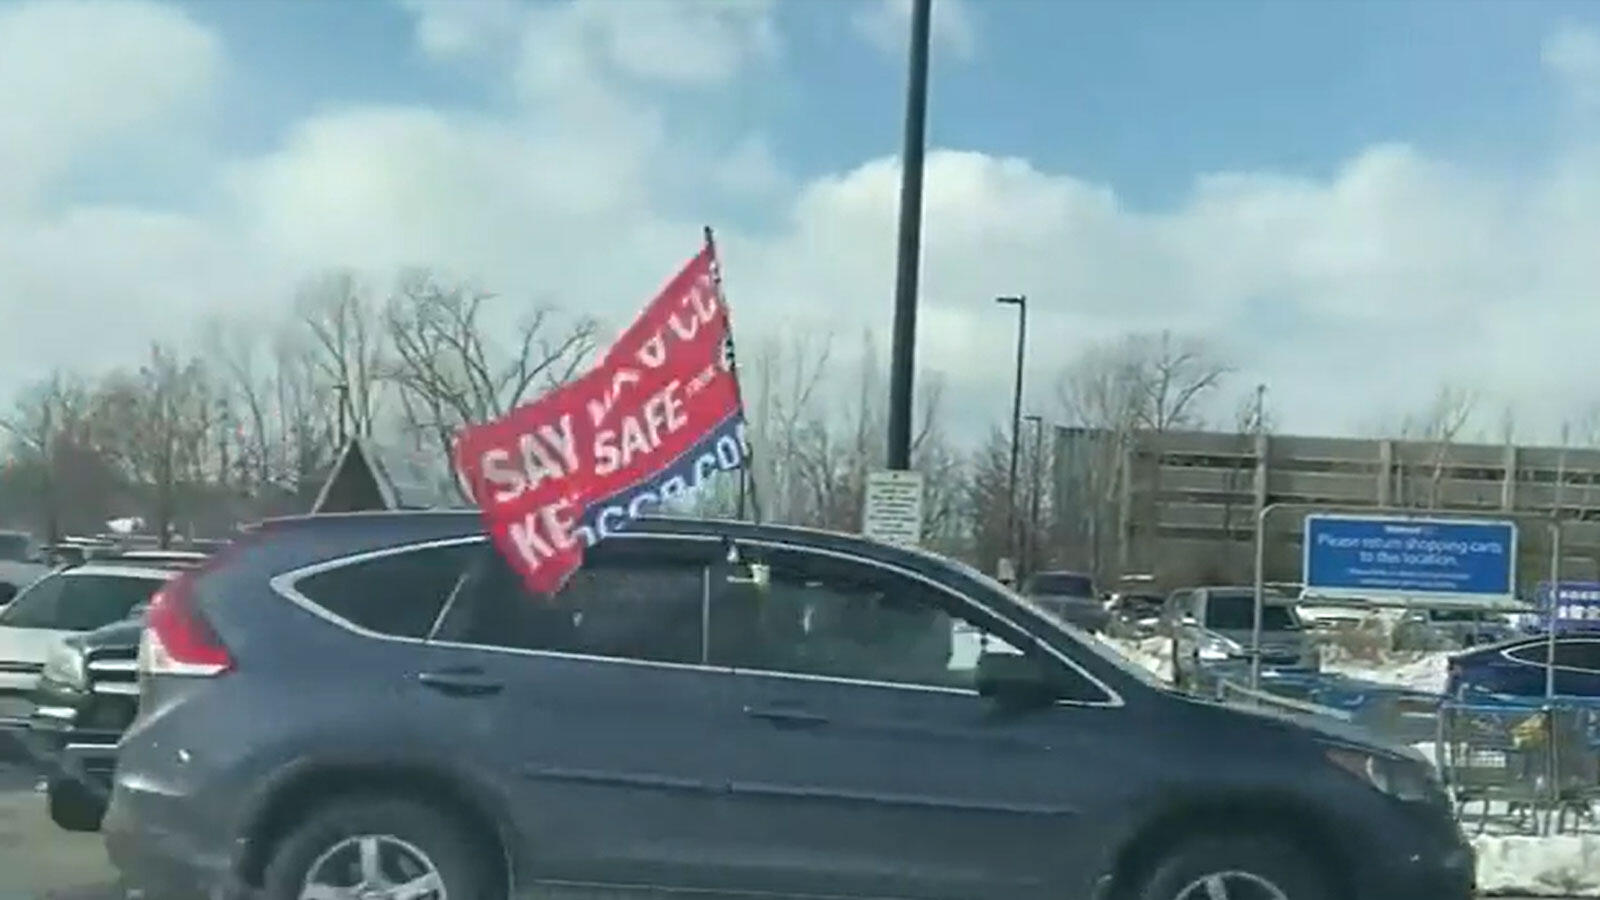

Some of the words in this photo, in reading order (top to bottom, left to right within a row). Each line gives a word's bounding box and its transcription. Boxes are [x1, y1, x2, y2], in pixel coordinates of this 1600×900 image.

[481, 414, 580, 503] SAY
[594, 381, 688, 475] SAFE
[1317, 533, 1360, 549] Please
[1405, 537, 1468, 555] shopping
